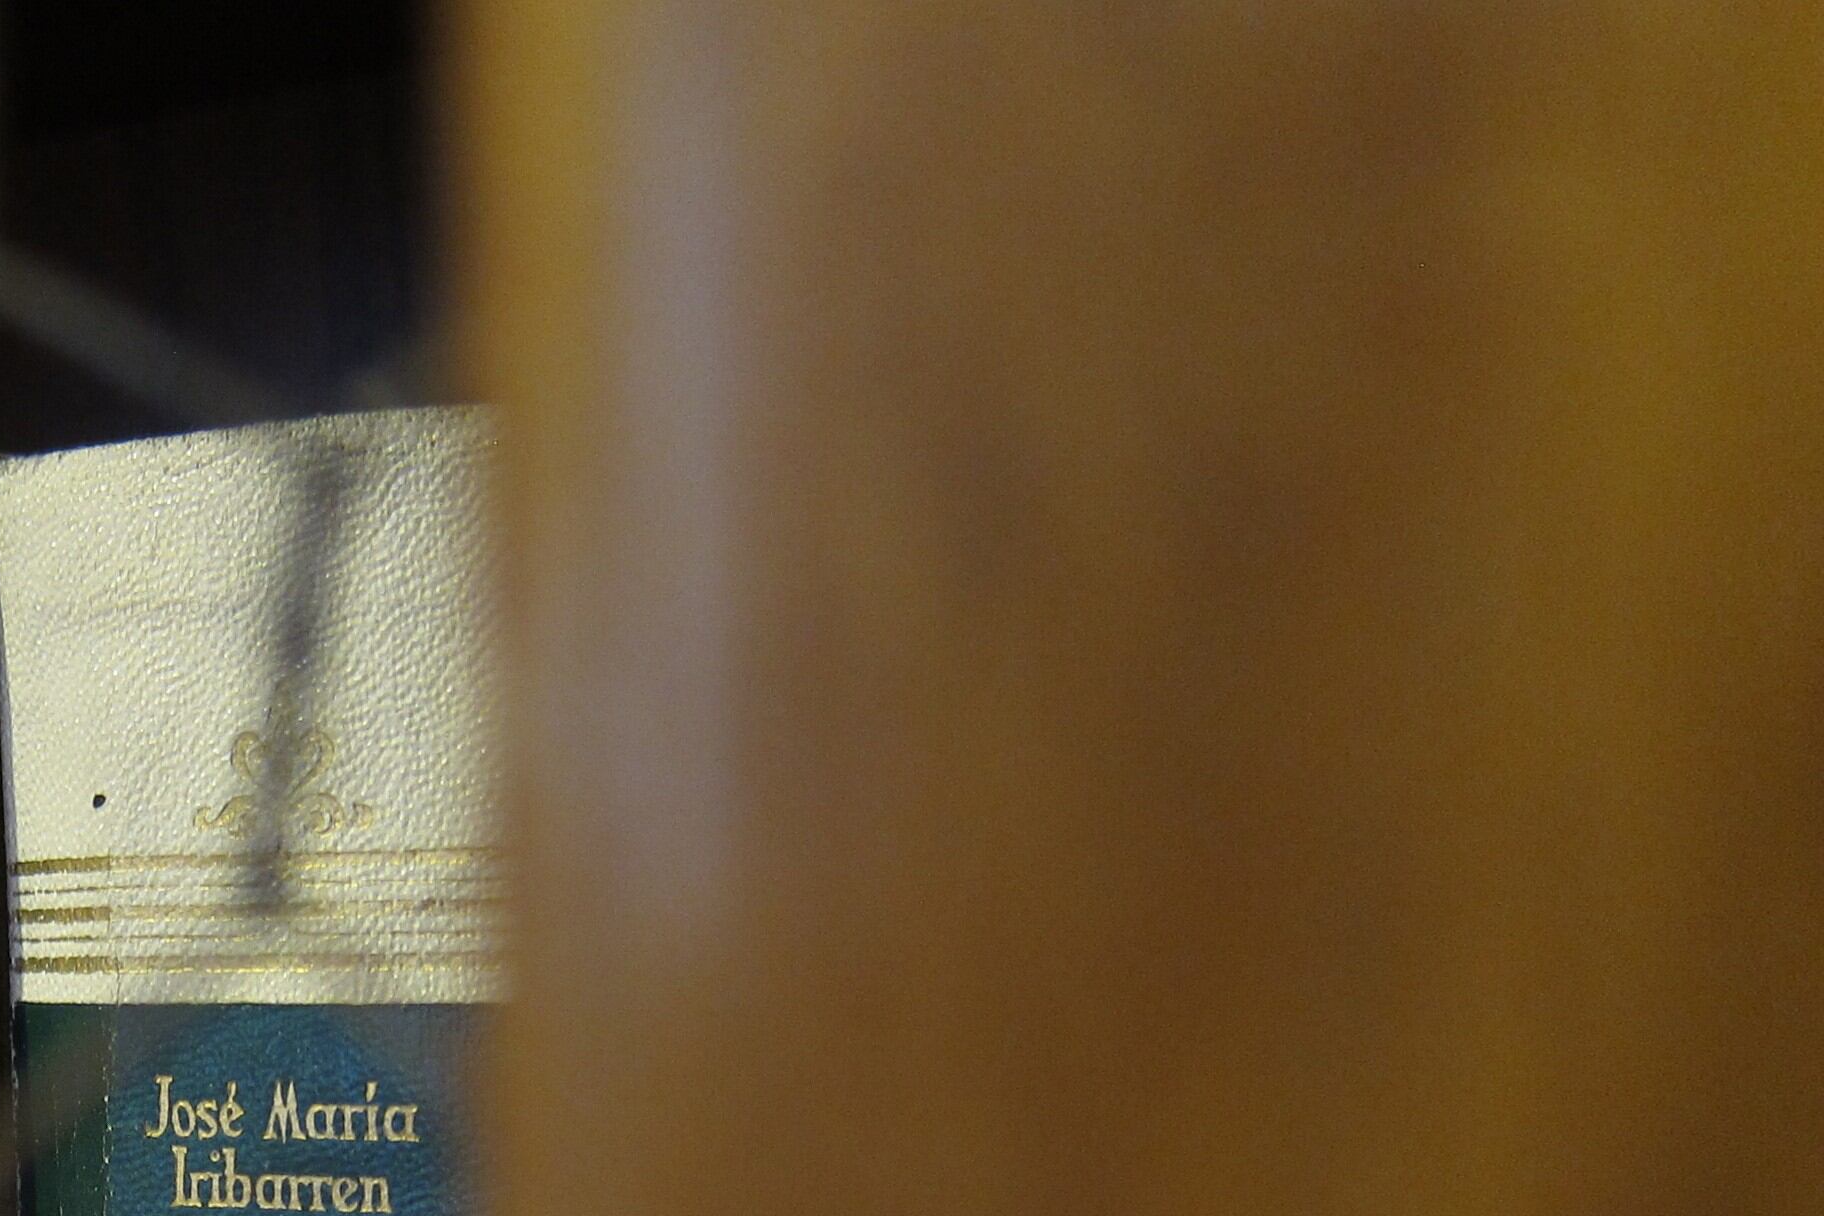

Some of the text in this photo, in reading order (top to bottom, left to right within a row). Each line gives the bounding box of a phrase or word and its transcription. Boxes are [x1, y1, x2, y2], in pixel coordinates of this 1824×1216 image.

[144, 1073, 421, 1143] José María
[169, 1144, 393, 1214] Iribarren
